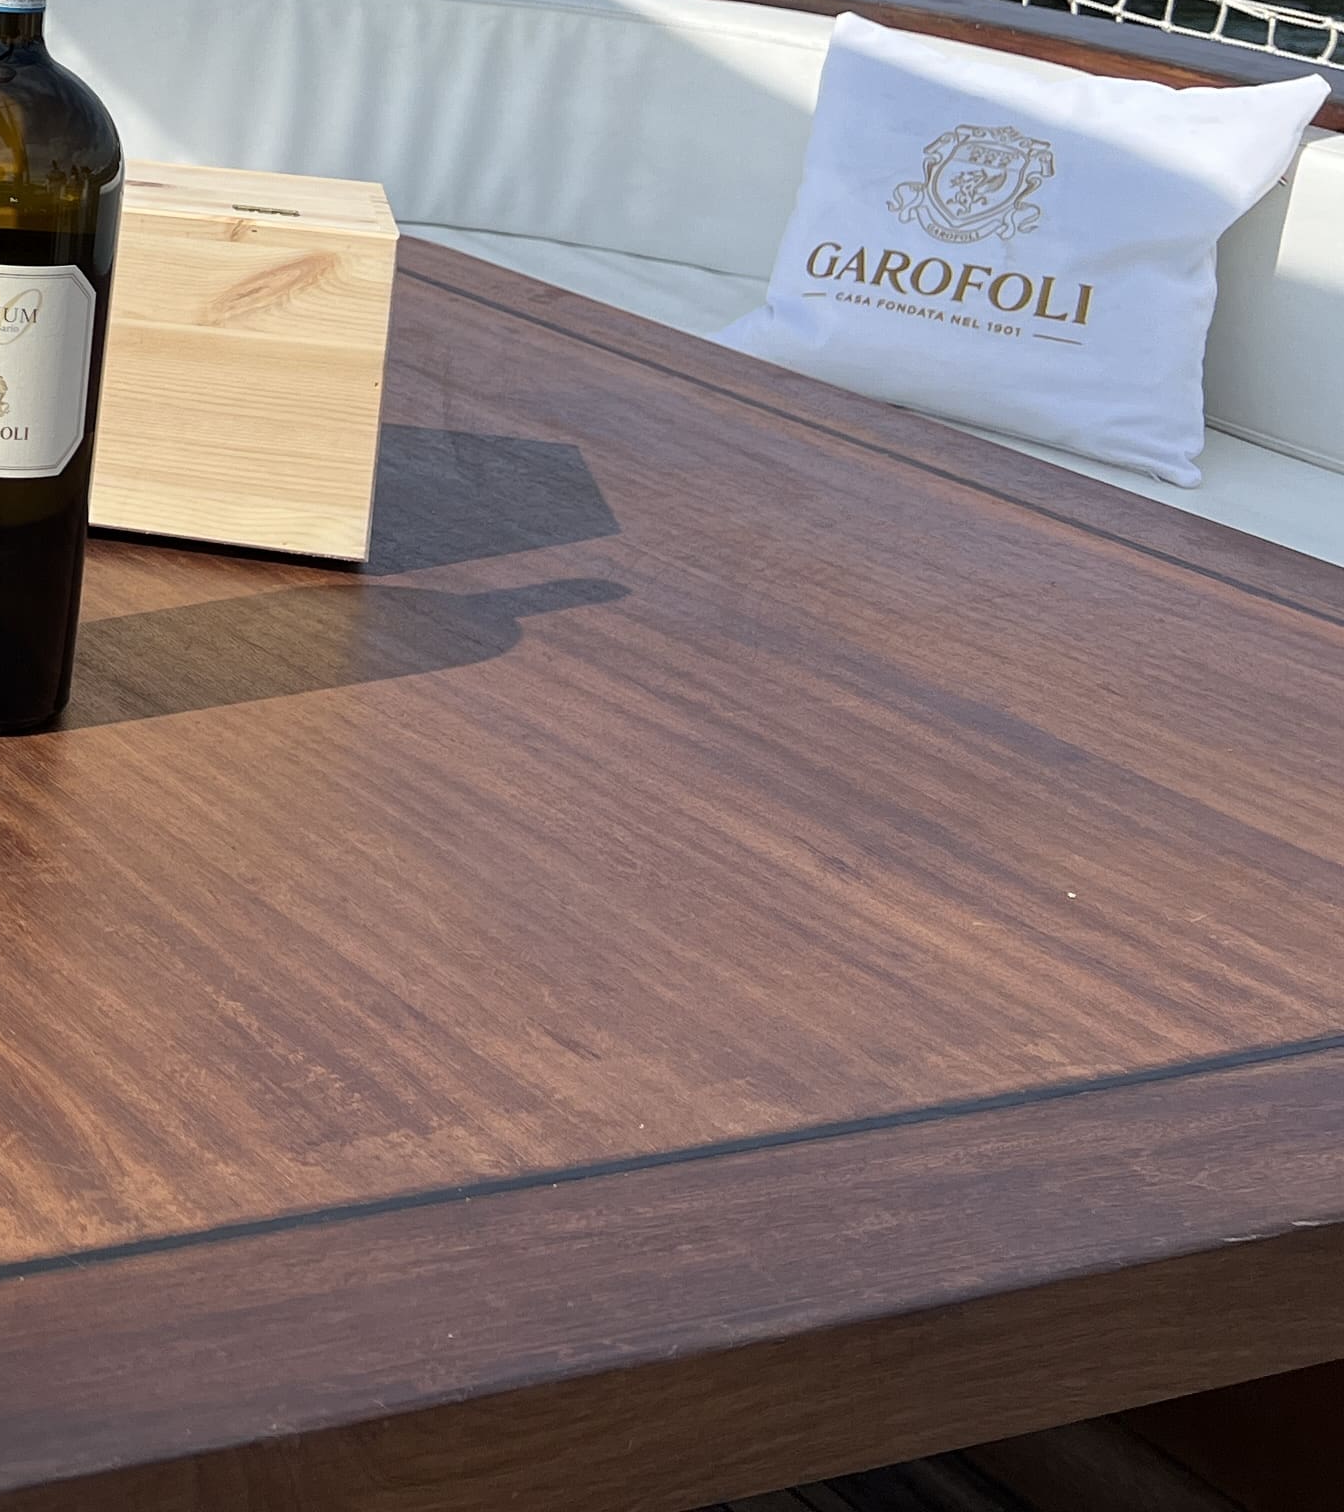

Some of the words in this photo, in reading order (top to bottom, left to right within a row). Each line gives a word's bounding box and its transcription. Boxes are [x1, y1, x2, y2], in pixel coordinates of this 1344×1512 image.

[806, 242, 1095, 325] GAROFOLI
[835, 291, 871, 306] CASA
[877, 299, 944, 322] FONDATA
[950, 314, 980, 329] NEL
[987, 321, 1022, 337] 1901
